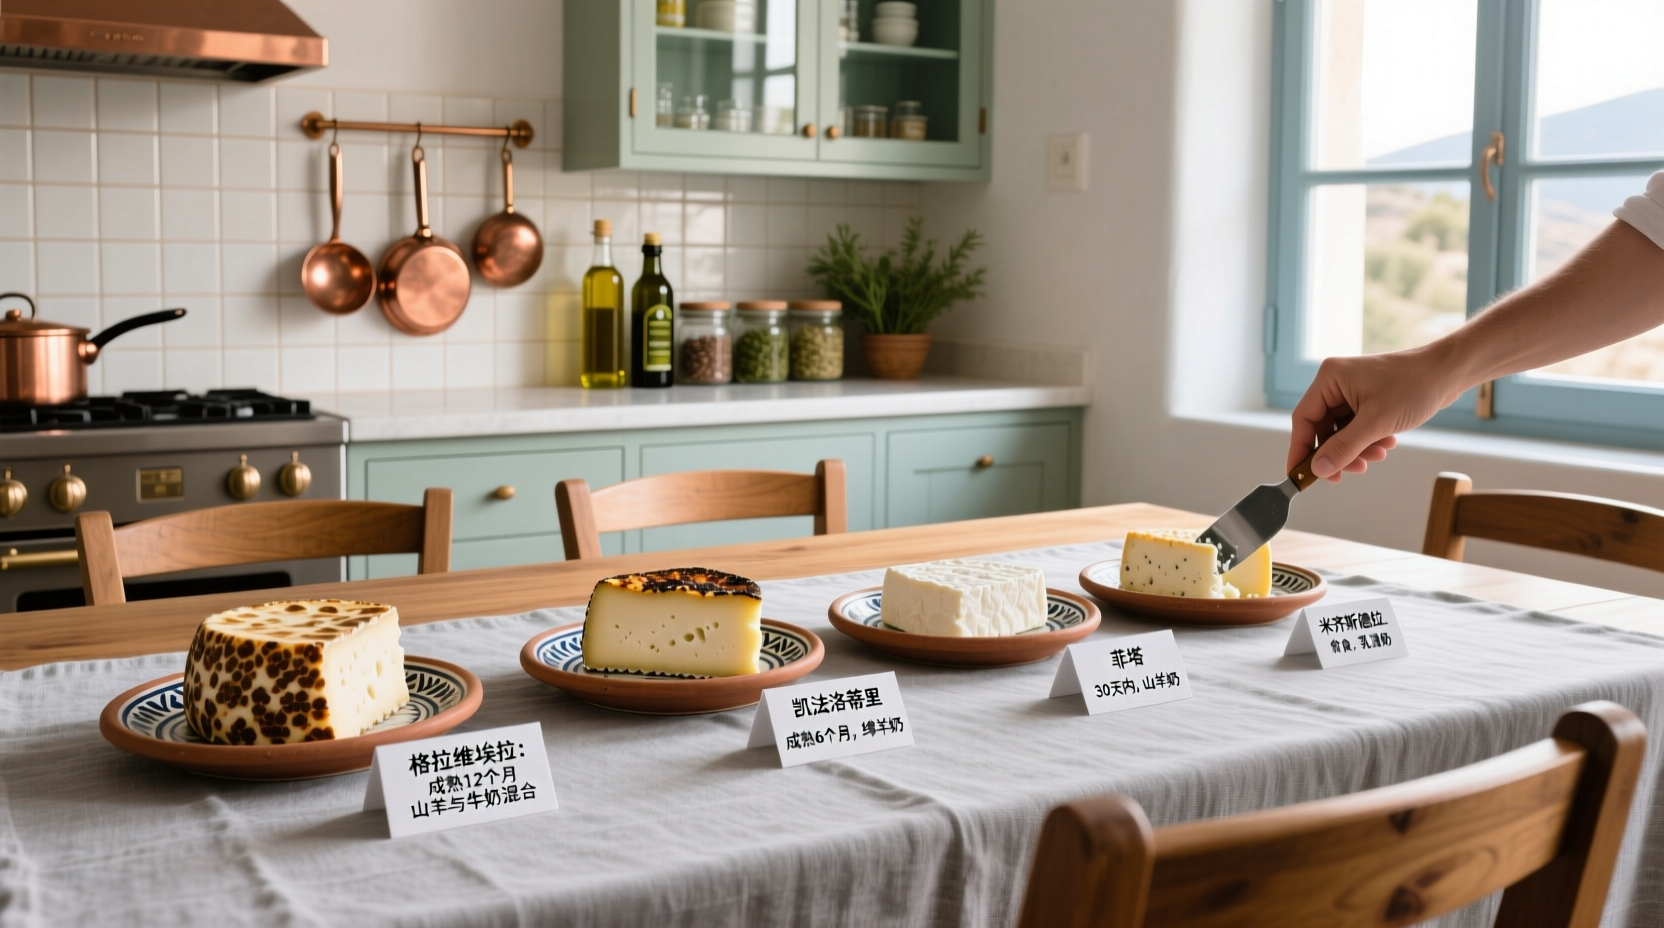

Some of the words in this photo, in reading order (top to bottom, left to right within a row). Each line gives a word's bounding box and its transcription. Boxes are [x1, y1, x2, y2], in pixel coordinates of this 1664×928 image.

[1110, 646, 1144, 669] 菲塔
[429, 766, 517, 796] 成熟12个月
[411, 782, 537, 818] 山羊与牛奶混合
